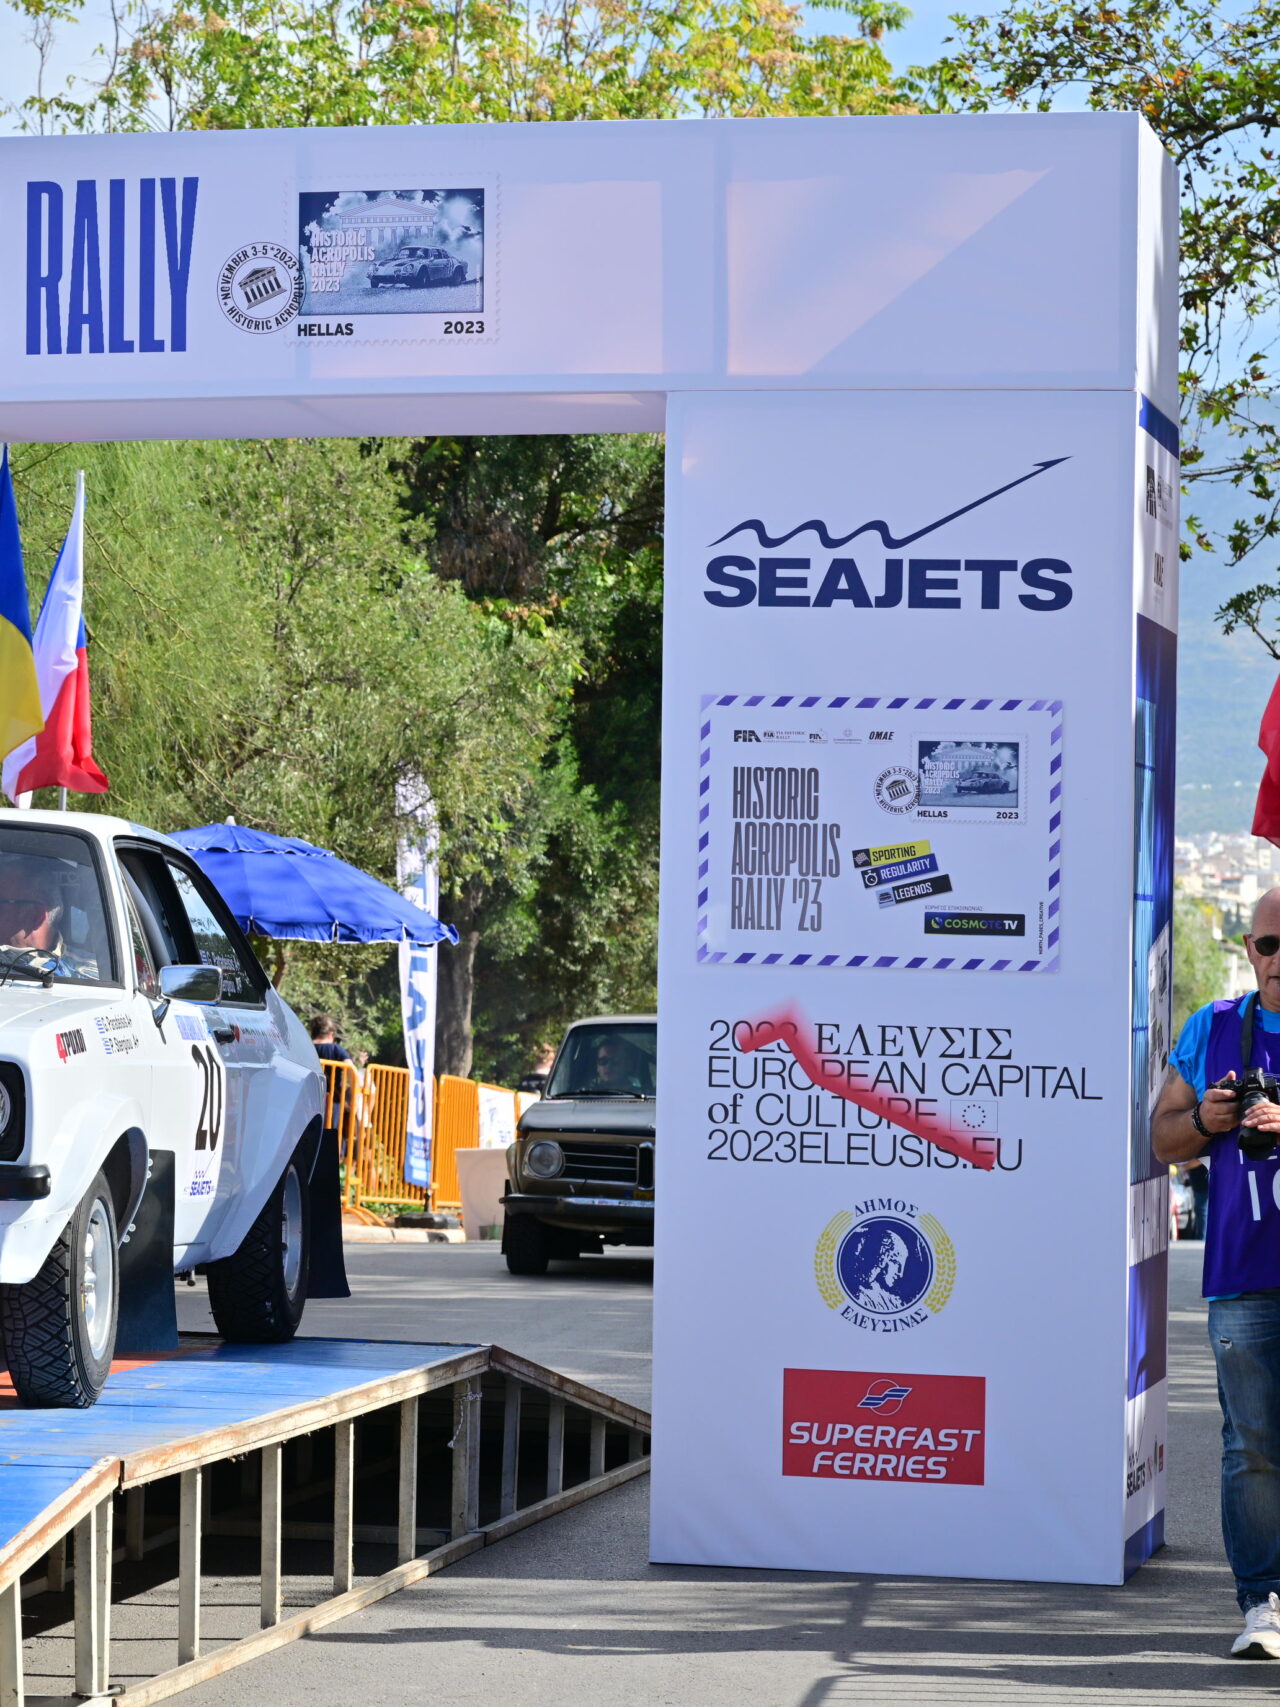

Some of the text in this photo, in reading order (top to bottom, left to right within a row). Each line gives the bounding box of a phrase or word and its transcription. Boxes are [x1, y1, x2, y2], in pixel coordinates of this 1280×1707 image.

[310, 231, 366, 247] HISTORIC
[26, 176, 200, 356] RALLY
[310, 247, 375, 263] ACROPOLIS
[221, 245, 297, 300] NOVEMBER 3-5 2023
[311, 262, 346, 278] RALLY
[311, 279, 341, 293] 2023
[227, 274, 305, 331] HISTORIC ACROPOLIS
[297, 323, 354, 337] HELLAS
[443, 321, 485, 335] 2023
[703, 554, 1073, 612] SEAJETS
[733, 729, 762, 743] FIA
[868, 731, 895, 741] OMAE
[732, 766, 819, 820] HISTORIC
[917, 810, 948, 818] HELLAS
[996, 811, 1019, 820] 2023
[731, 821, 841, 878] ACROPOLIS
[872, 845, 916, 862] SPORTING
[880, 858, 931, 880] REGULARITY
[894, 882, 933, 900] LEGENDS
[730, 877, 785, 931] RALLY
[944, 918, 1018, 930] COSMOTE TV
[707, 1055, 1103, 1100] EUROPEAN CAPITAL
[191, 1043, 222, 1152] 20
[707, 1092, 938, 1131] of CULTURE
[706, 1128, 1023, 1172] 2023ELEUSIS.EU
[853, 1198, 920, 1219] ΔΗΜΟΣ
[840, 1303, 929, 1333] ΕΛΕΥΣΙΝΑΣ
[789, 1421, 981, 1453] SUPERFAST
[812, 1450, 949, 1480] FERRIES
